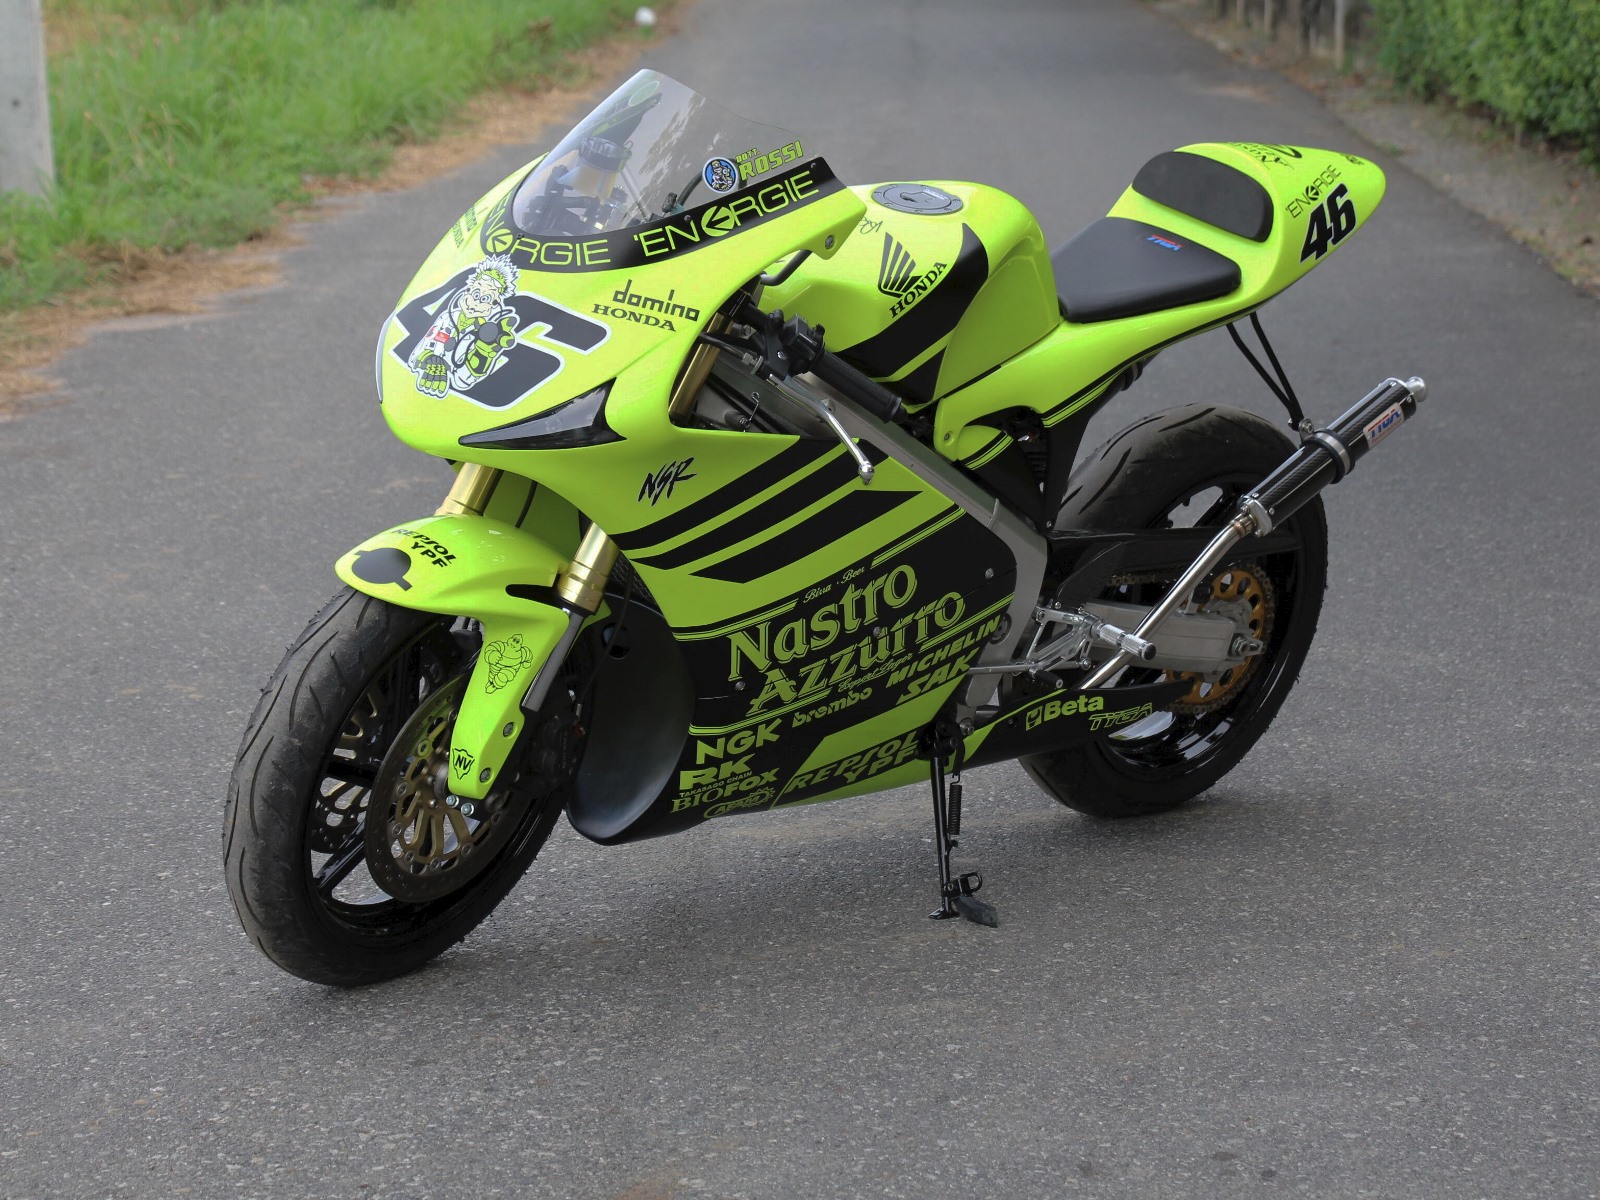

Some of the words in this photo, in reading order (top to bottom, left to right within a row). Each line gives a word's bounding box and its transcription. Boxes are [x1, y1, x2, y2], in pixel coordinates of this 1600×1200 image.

[738, 140, 804, 181] ROSSI
[1299, 182, 1357, 264] 46
[612, 279, 701, 322] domino
[888, 261, 949, 319] HONDA
[591, 303, 677, 332] HONDA
[637, 456, 698, 507] NSR
[411, 542, 448, 568] YPF
[802, 583, 833, 604] Birra
[840, 566, 865, 584] Beer
[725, 564, 918, 682] Nastro
[745, 591, 966, 718] Azzurro
[886, 614, 1001, 689] MICHELIN
[791, 687, 873, 728] brembo
[1043, 694, 1104, 722] Beta
[454, 754, 474, 771] NV
[695, 717, 783, 765] NGK
[784, 730, 920, 794] REPSOL
[842, 740, 919, 784] YPF
[679, 753, 756, 790] RK
[679, 780, 725, 798] TAKASAGO
[726, 770, 753, 784] CHAIN
